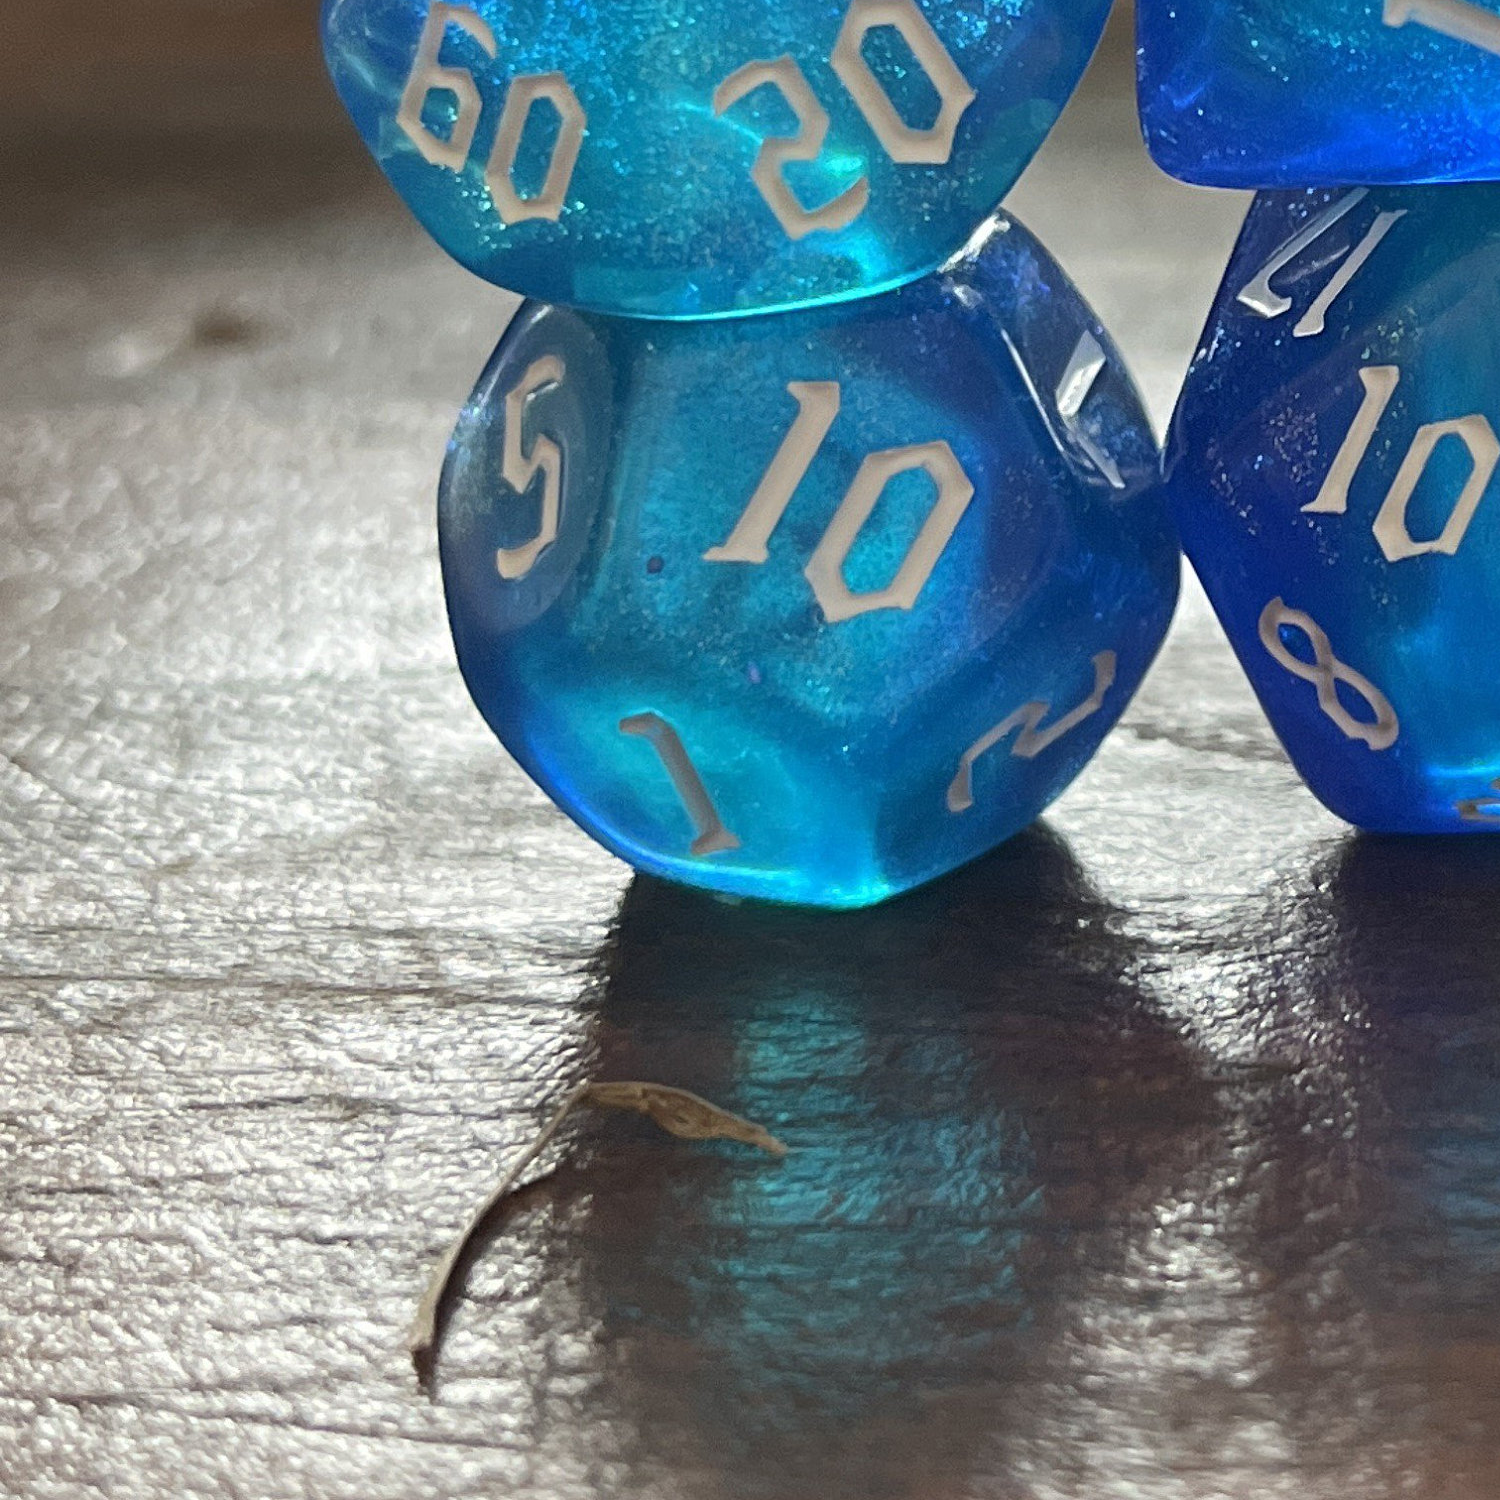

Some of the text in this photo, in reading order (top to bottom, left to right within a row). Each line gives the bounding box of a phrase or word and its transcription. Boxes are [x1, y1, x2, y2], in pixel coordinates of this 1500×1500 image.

[496, 355, 565, 579] 5
[702, 381, 975, 623] 10
[948, 650, 1116, 812] 2
[1259, 596, 1399, 750] 8
[619, 711, 741, 855] 1
